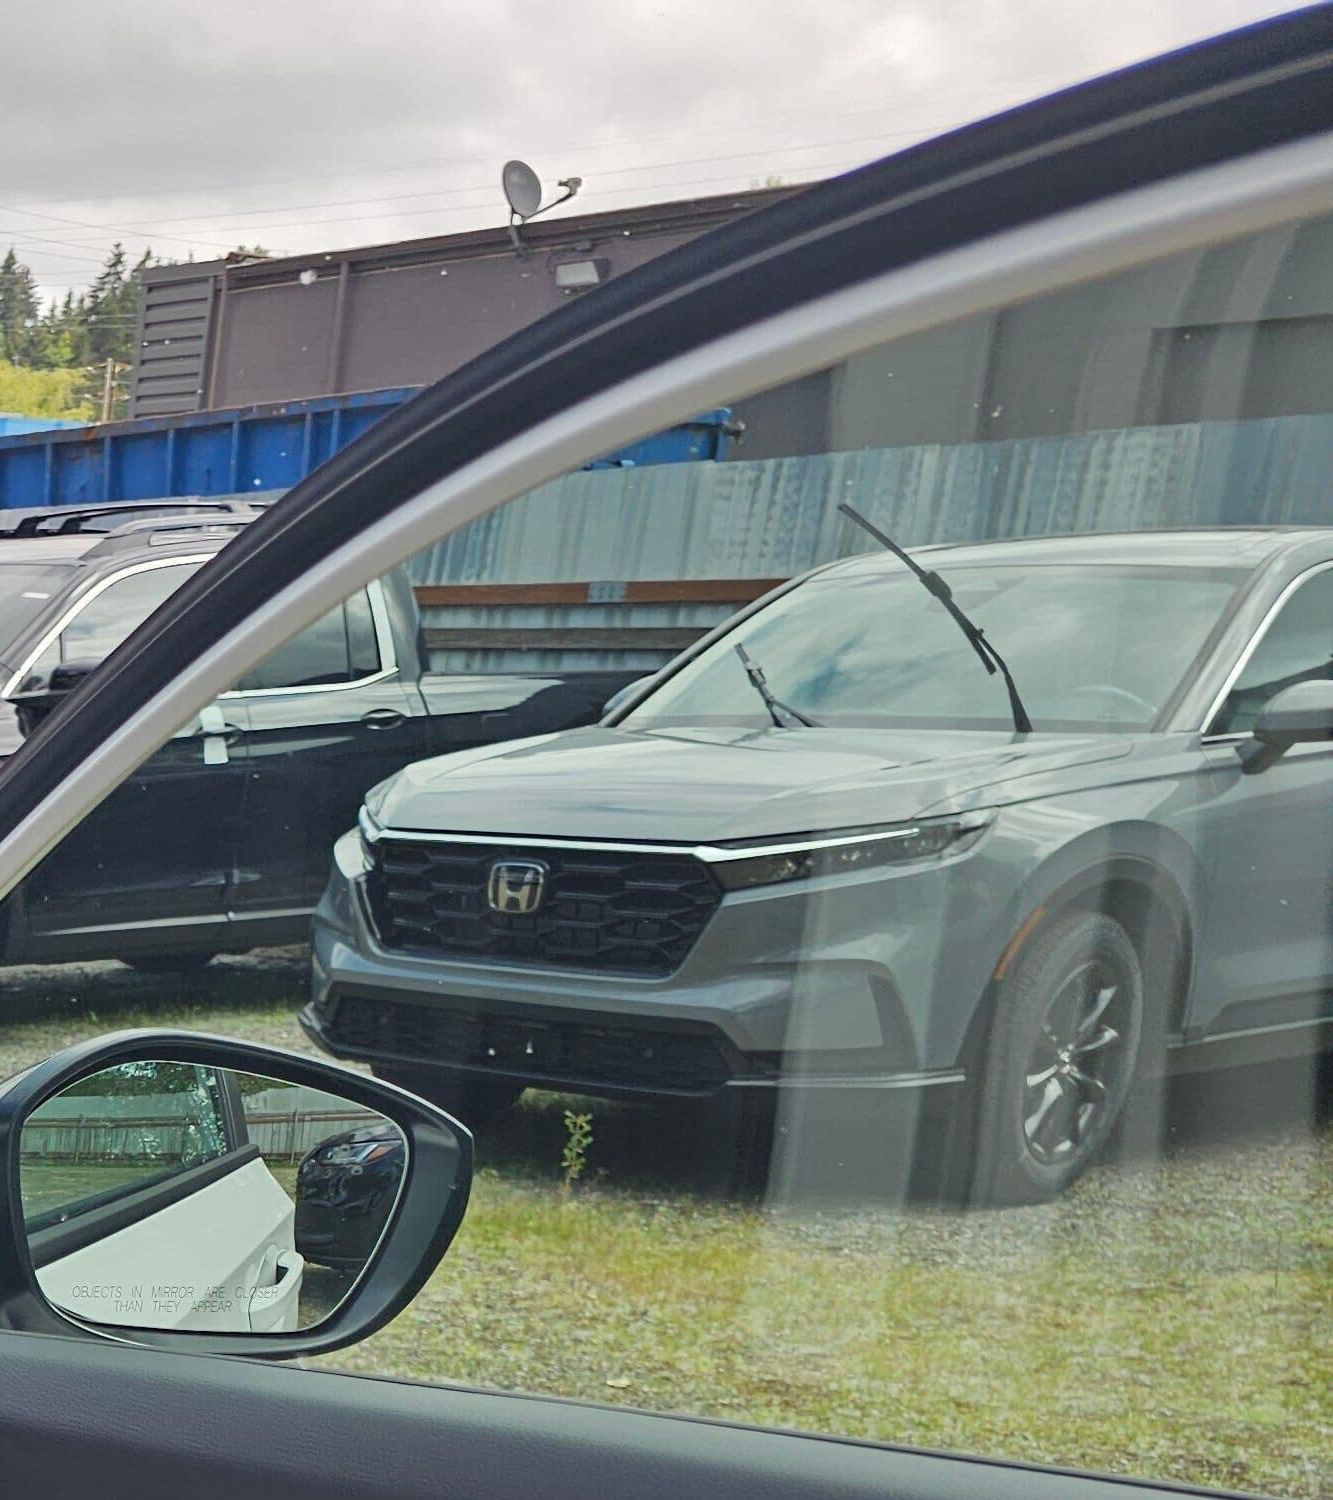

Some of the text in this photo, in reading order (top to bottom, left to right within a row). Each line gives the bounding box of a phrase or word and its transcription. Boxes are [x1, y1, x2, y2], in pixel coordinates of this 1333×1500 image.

[72, 1286, 279, 1299] OBJECTS IN MIRROR ARE CLOSER
[114, 1300, 232, 1312] THAN THEY APPEAR
